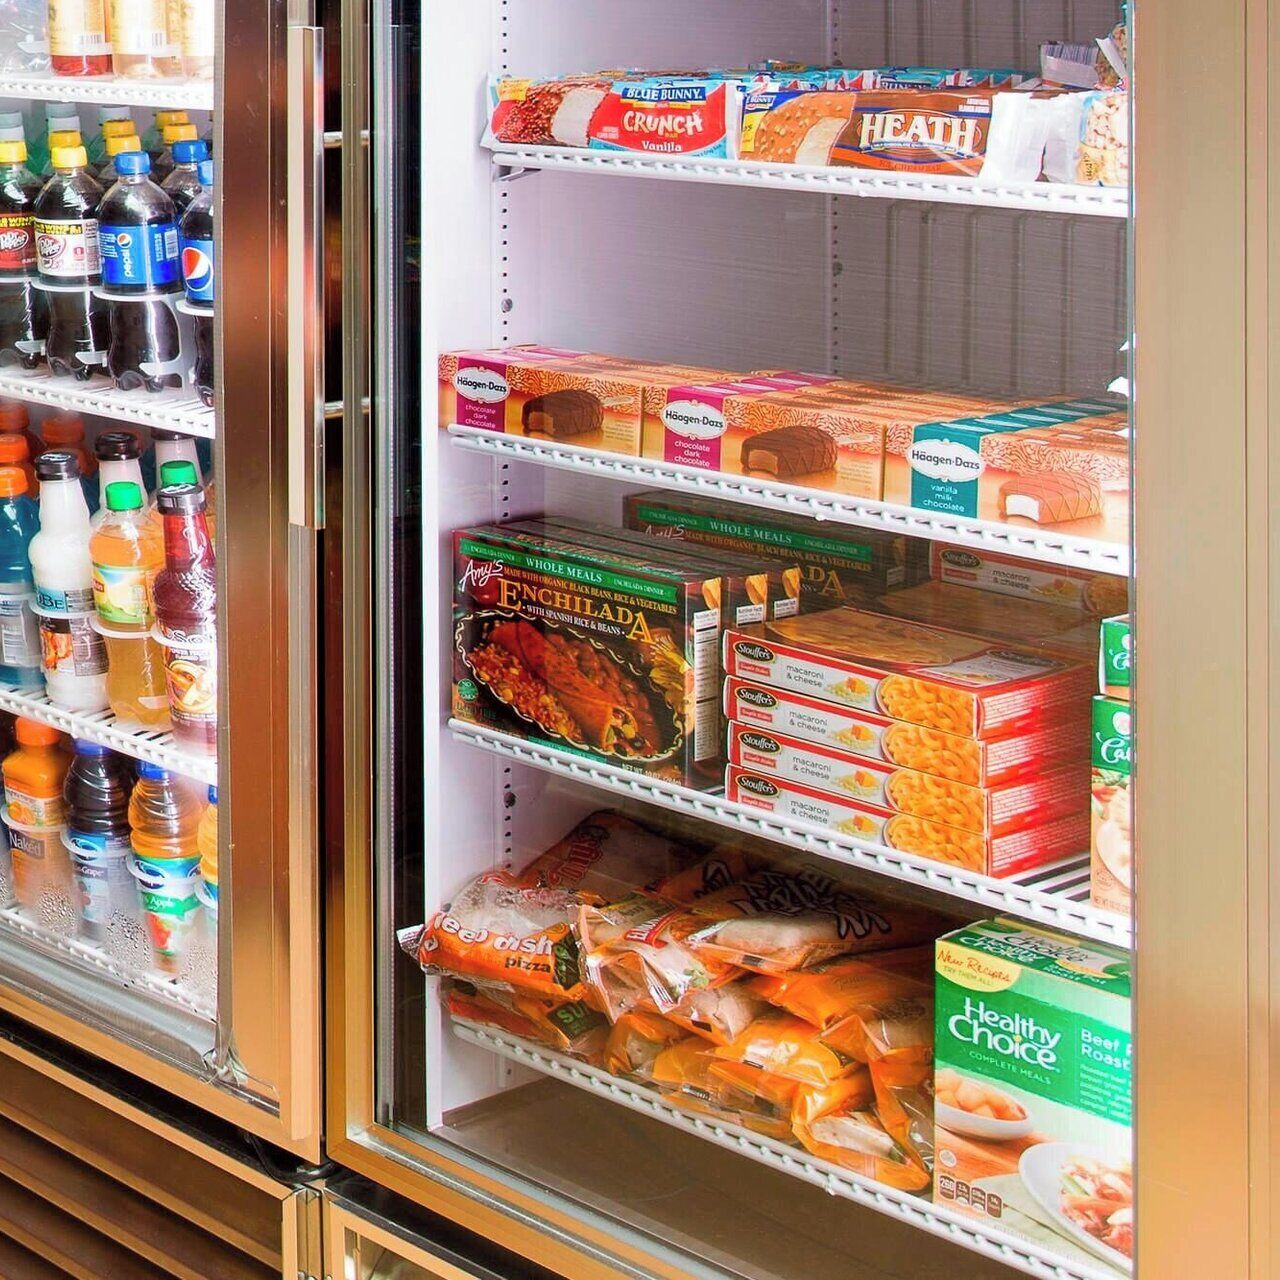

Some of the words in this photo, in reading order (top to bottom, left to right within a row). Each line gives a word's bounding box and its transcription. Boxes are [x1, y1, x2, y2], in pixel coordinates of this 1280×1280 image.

[627, 87, 659, 101] BLUE
[661, 87, 702, 100] BUNNY
[751, 95, 773, 104] BUNNY
[623, 110, 703, 136] CRUNCH
[859, 113, 979, 158] HEATH
[642, 140, 683, 152] Vanilla
[125, 246, 133, 278] pepsi
[465, 404, 496, 415] chocolate
[473, 411, 488, 421] dark
[465, 418, 496, 429] chocolate
[674, 440, 711, 453] chocolate
[684, 448, 700, 458] dark
[674, 455, 711, 468] chocolate
[931, 484, 958, 495] vanilla
[935, 493, 953, 501] milk
[923, 499, 965, 512] chocolate
[709, 521, 751, 538] WHOLE
[754, 528, 793, 544] MEALS
[459, 559, 504, 592] Amy's
[526, 557, 565, 575] WHOLE
[566, 566, 603, 583] MEALS
[613, 579, 643, 592] ENCHILADA
[643, 585, 664, 596] DINNER
[504, 566, 522, 578] MADE
[522, 570, 539, 582] WITH
[539, 575, 569, 589] ORGANIC
[569, 582, 590, 594] BLACK
[613, 593, 629, 604] RICE
[635, 598, 678, 615] VEGETABLES
[496, 577, 658, 645] ENCHILADA
[526, 604, 545, 618] WITH
[545, 609, 574, 625] SPANISH
[573, 616, 590, 629] RICE
[597, 622, 621, 636] BEANS
[738, 642, 773, 660] Stouffer's
[786, 663, 824, 679] macaroni
[794, 673, 823, 688] cheese
[739, 687, 775, 707] Stouffer's
[789, 709, 827, 726] macaroni
[797, 719, 826, 735] cheese
[742, 732, 778, 752] Stouffer's
[792, 755, 831, 772] macaroni
[800, 765, 830, 781] cheese
[739, 776, 775, 796] Stouffer's
[790, 799, 830, 816] macaroni
[798, 809, 829, 824] cheese
[10, 827, 42, 855] Naked
[81, 865, 104, 878] Grape
[149, 895, 174, 909] Apple
[492, 935, 554, 955] dish
[504, 954, 552, 974] pizza
[937, 949, 962, 968] New
[964, 997, 1061, 1048] Healthy
[948, 1014, 1058, 1071] Choice
[1081, 1029, 1120, 1053] Beef
[968, 1051, 1018, 1075] COMPLETE
[1019, 1067, 1052, 1086] MEALS
